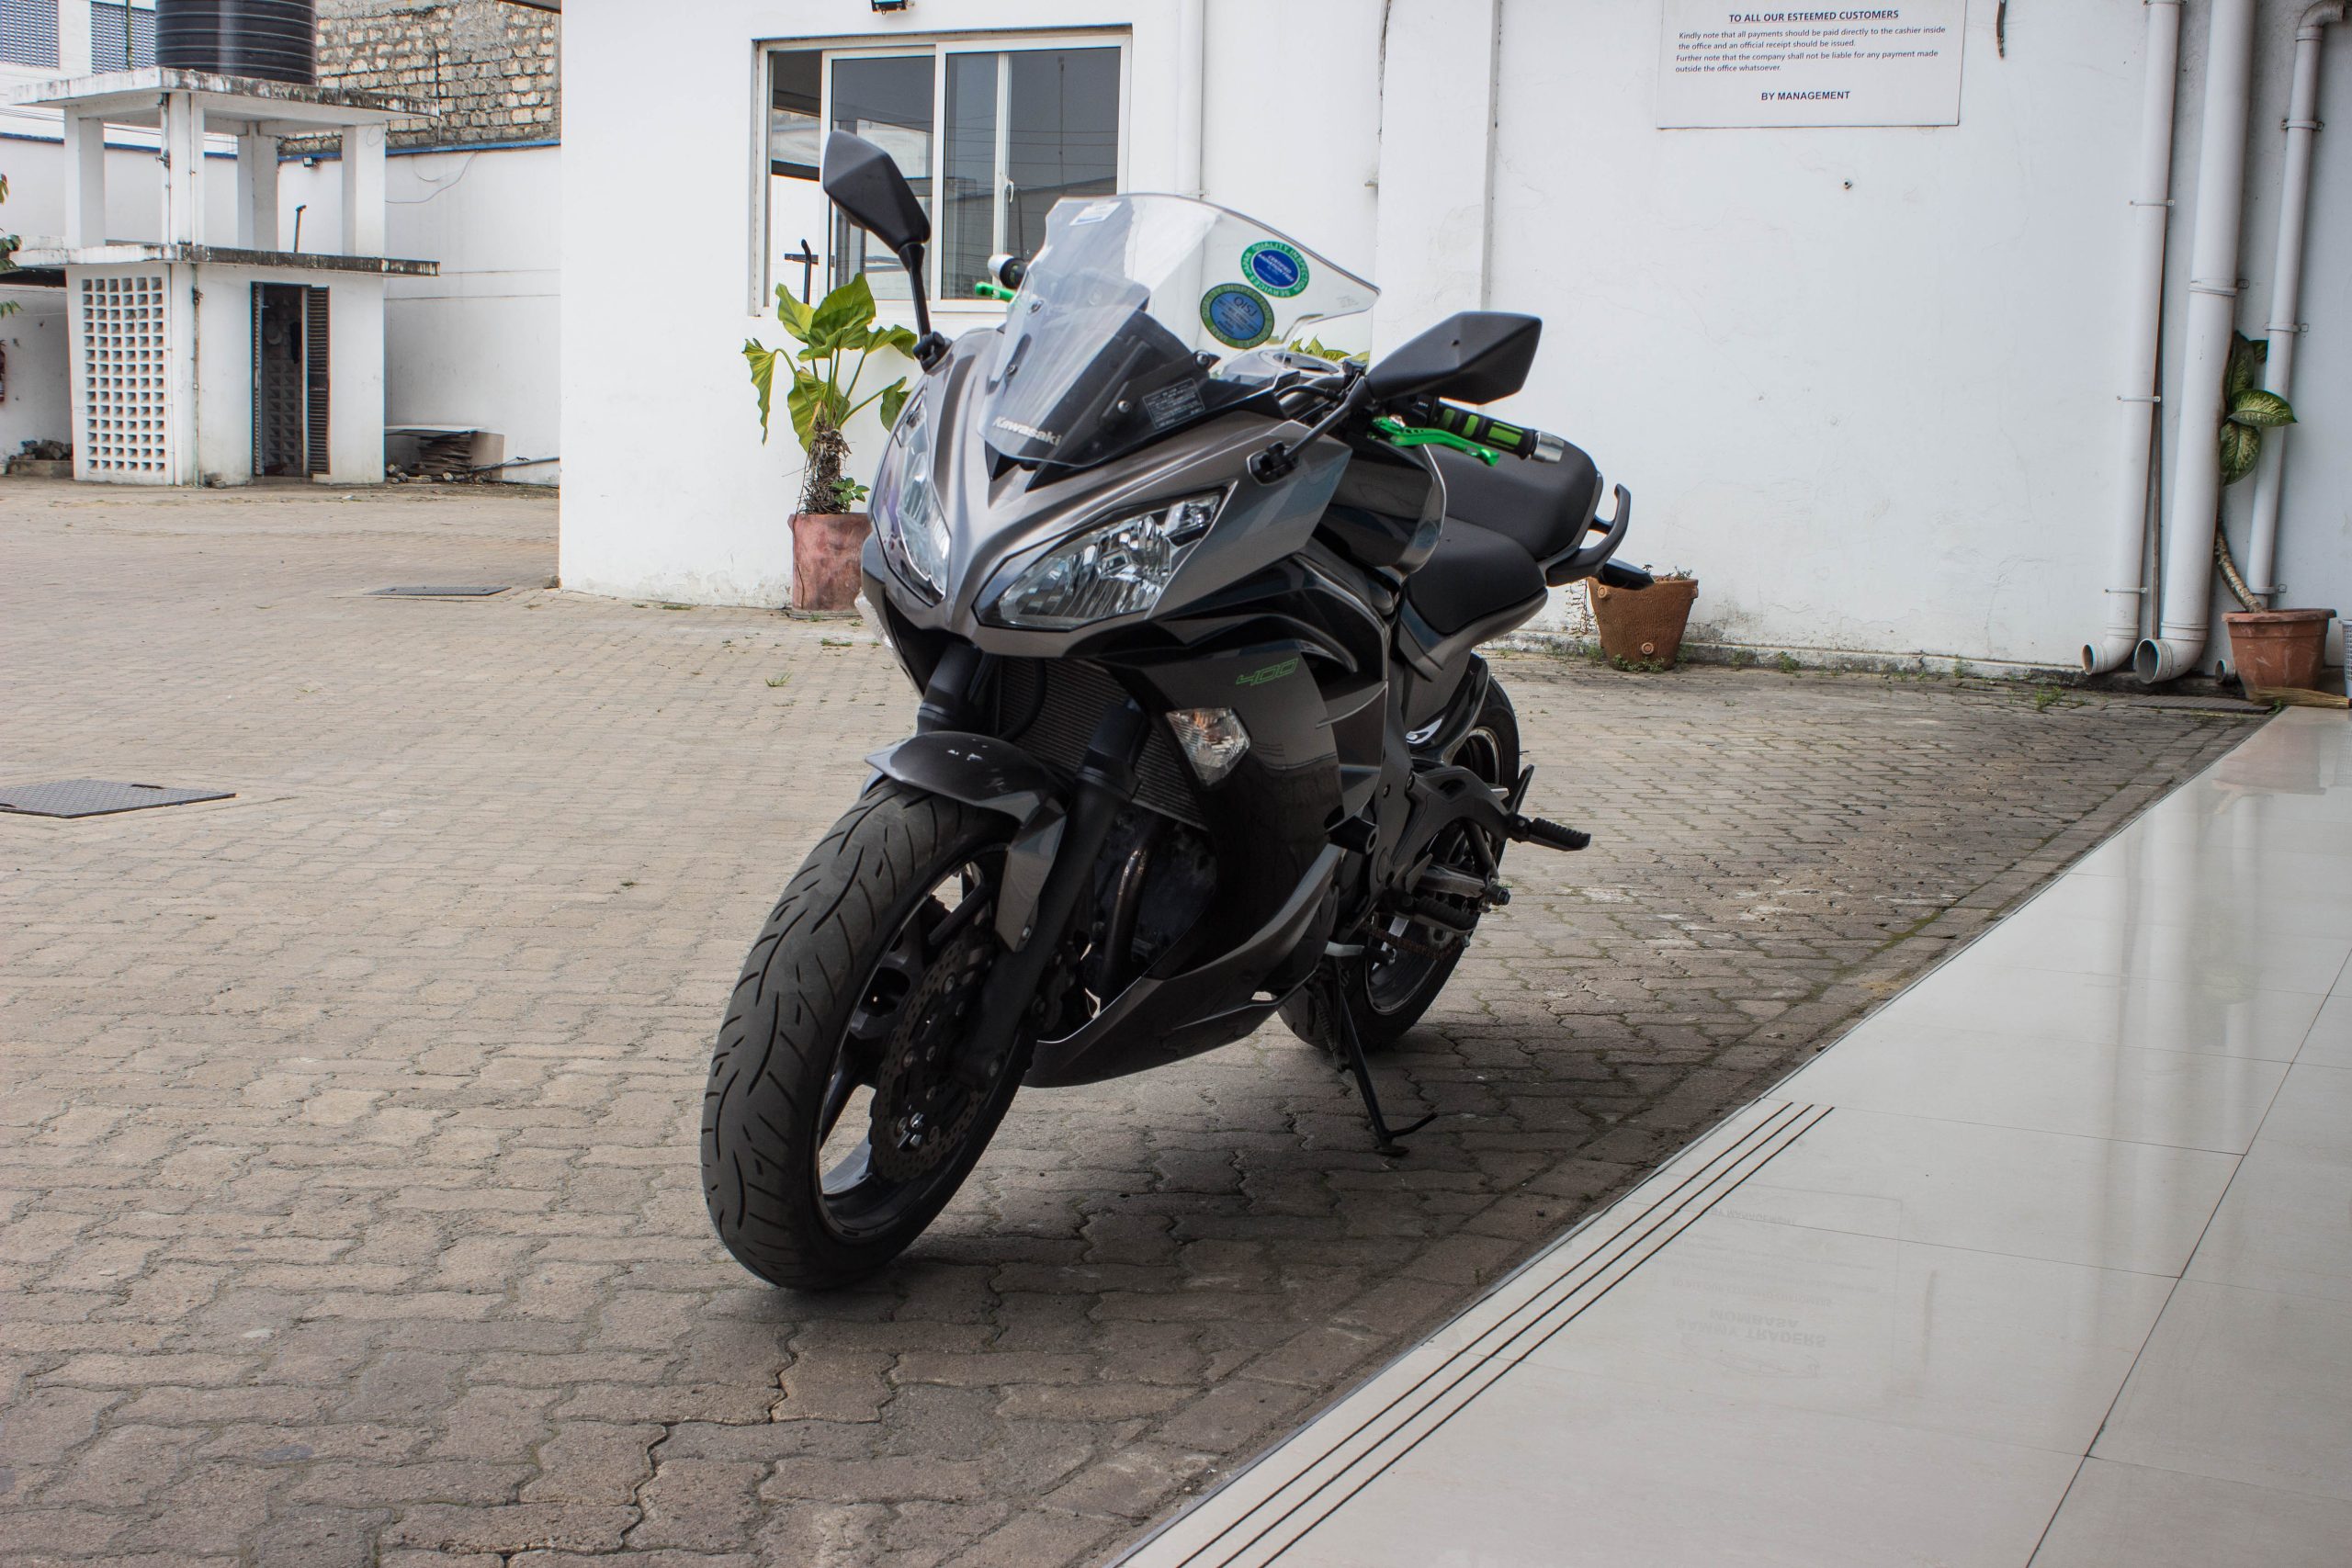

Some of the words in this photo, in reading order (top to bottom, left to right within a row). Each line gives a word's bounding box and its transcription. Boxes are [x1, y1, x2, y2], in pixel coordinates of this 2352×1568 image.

[1729, 14, 1741, 22] TO
[1744, 14, 1761, 22] ALL
[1763, 13, 1784, 21] OUR
[1787, 12, 1837, 21] ESTEEMED
[1839, 10, 1899, 19] CUSTOMERS
[1679, 32, 1702, 40] Kindly
[1823, 28, 1839, 37] paid
[1840, 28, 1869, 36] directly
[1766, 41, 1792, 50] receipt
[1882, 51, 1915, 59] payment
[1761, 92, 1775, 101] BY
[1777, 91, 1850, 101] MANAGEMENT
[1268, 255, 1292, 274] CERTIFIED
[1250, 276, 1290, 297] SERVICES
[1234, 297, 1258, 317] QISJ
[992, 416, 1062, 447] Kawasaki
[1236, 658, 1299, 686] 400
